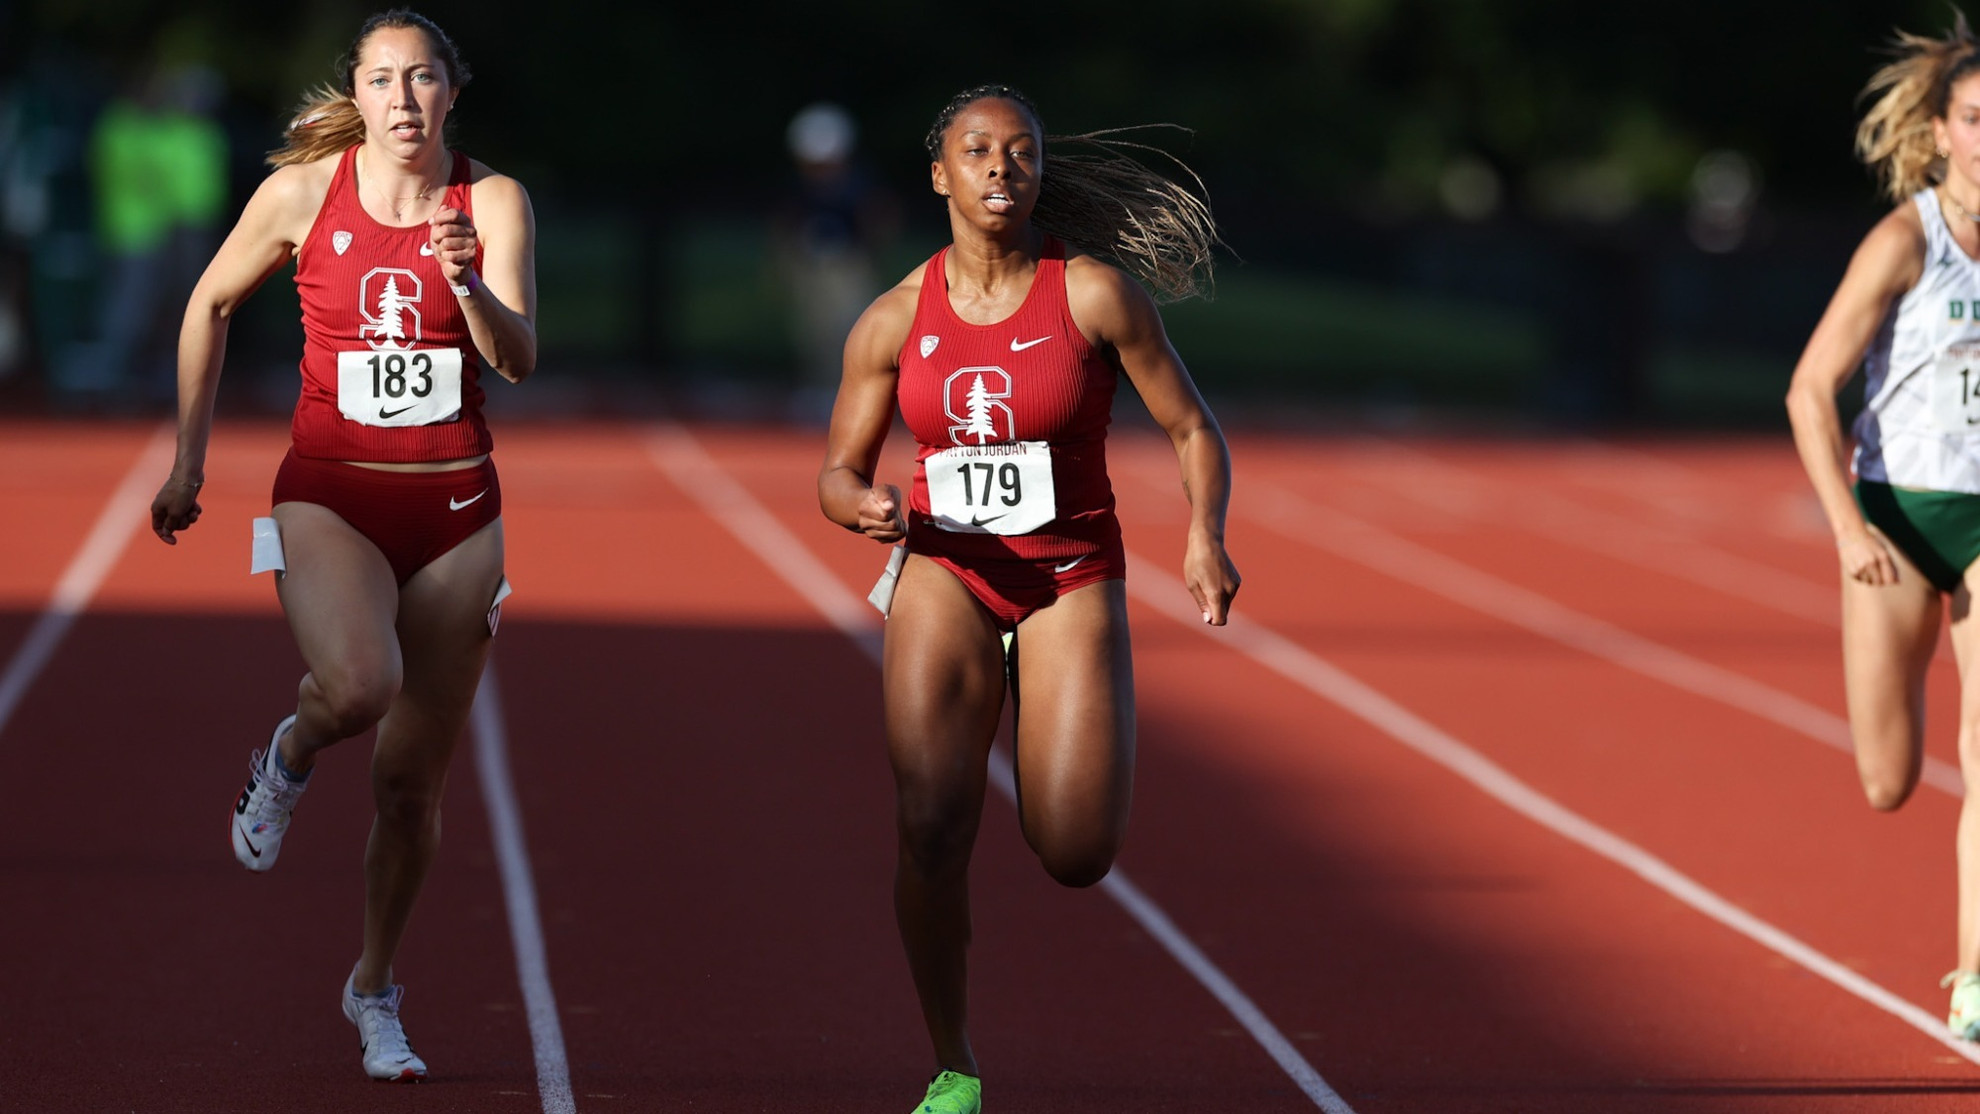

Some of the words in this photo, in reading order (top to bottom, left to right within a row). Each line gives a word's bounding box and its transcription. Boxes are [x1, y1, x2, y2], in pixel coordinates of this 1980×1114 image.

[367, 353, 433, 398] 183
[984, 442, 1027, 456] JORDAN
[957, 462, 1022, 507] 179
